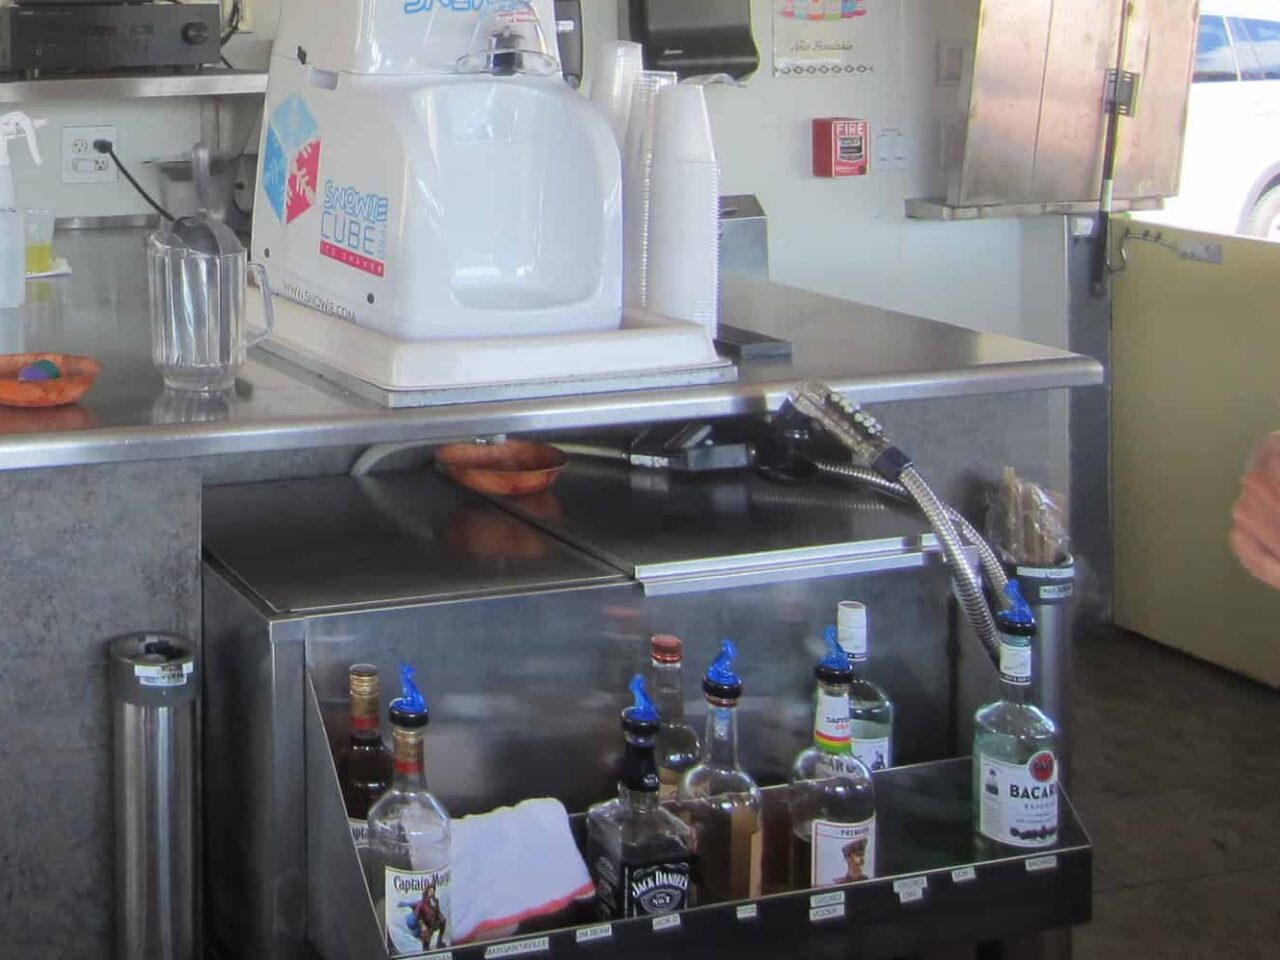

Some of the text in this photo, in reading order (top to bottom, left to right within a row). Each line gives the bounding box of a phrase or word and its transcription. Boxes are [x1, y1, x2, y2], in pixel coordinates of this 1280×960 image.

[836, 123, 865, 136] FIRE
[324, 178, 389, 223] SNOWIE
[321, 210, 376, 256] CUBE
[393, 874, 430, 892] Captain
[632, 870, 689, 898] JACK DANIEL'S
